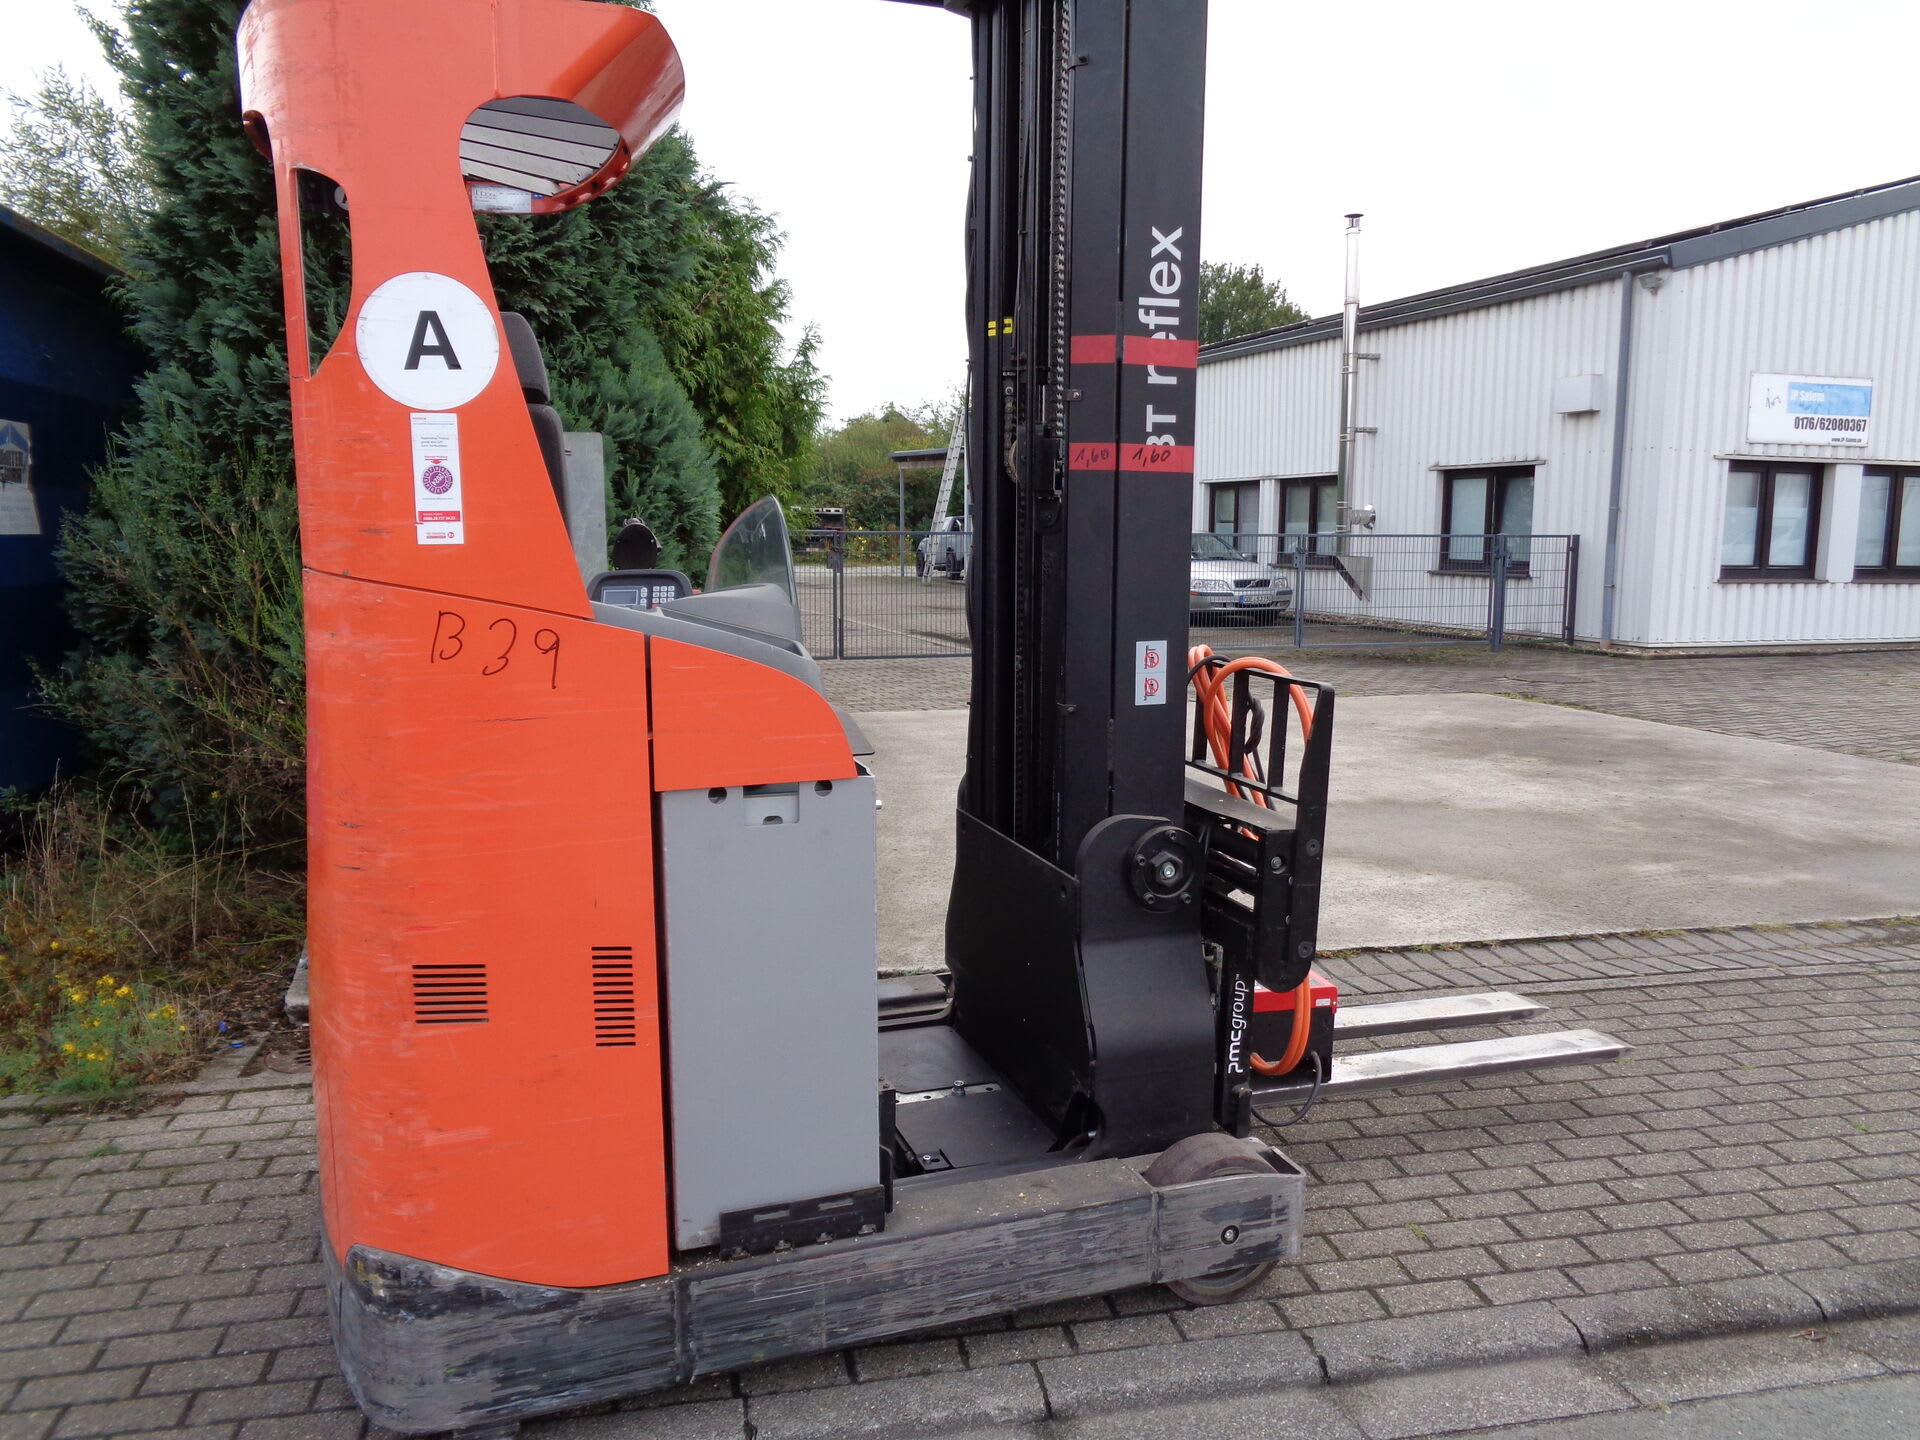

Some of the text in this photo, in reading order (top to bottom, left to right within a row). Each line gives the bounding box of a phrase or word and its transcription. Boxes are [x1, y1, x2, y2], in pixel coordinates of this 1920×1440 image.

[1138, 226, 1183, 385] rflex
[404, 310, 462, 370] A
[1794, 416, 1867, 432] 0176/62080367
[1132, 447, 1172, 468] 1,60
